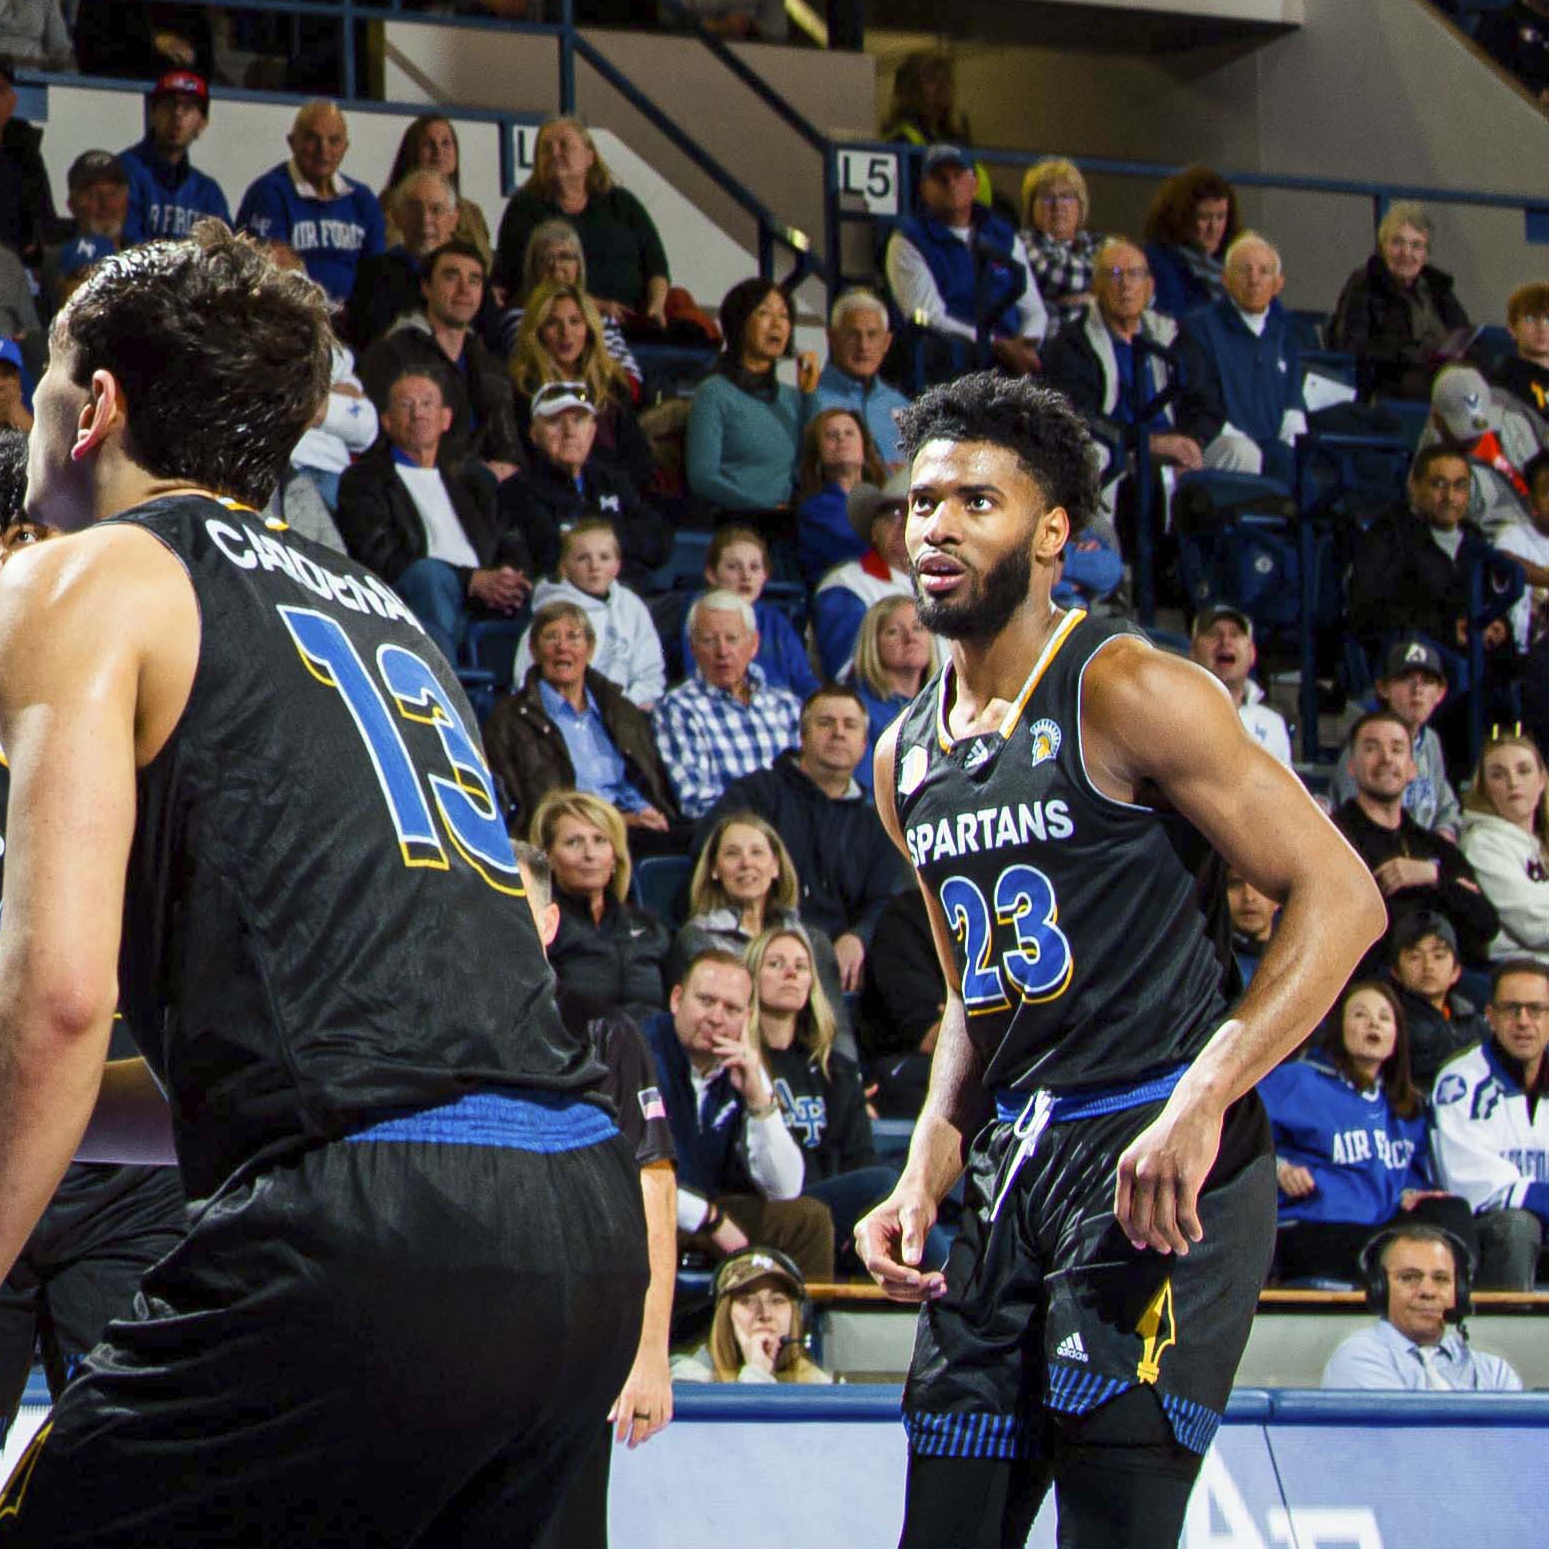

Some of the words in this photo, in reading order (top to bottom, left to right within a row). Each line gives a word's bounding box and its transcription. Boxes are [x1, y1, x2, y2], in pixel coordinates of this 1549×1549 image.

[843, 155, 891, 198] L5
[204, 518, 426, 637] CARDENA
[276, 603, 526, 897] 13
[905, 799, 1076, 868] SPARTANS
[939, 863, 1074, 1017] 23
[1332, 1129, 1372, 1165] AIR
[1056, 1346, 1089, 1363] adidas
